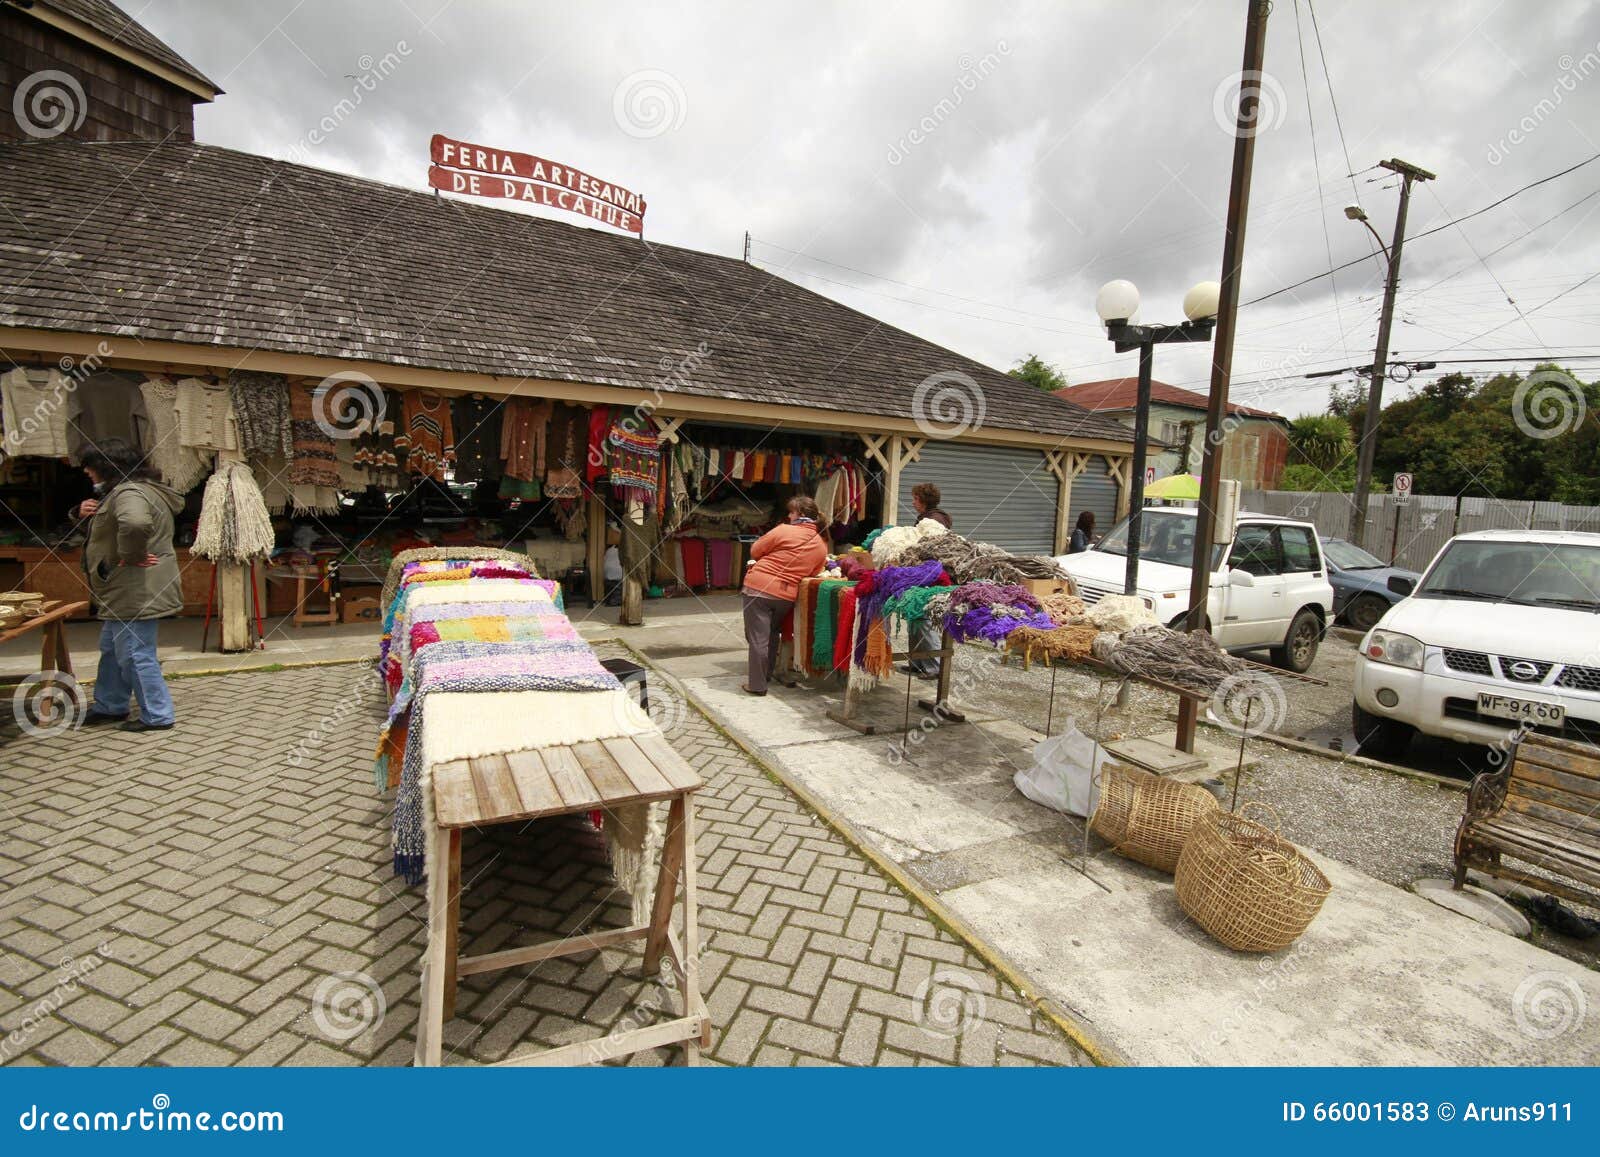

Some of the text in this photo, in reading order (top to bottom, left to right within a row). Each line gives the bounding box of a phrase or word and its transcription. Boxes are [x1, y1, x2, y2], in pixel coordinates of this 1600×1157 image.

[443, 143, 643, 215] FERIA ARTESANAL
[452, 172, 631, 230] DE DALCAHUE
